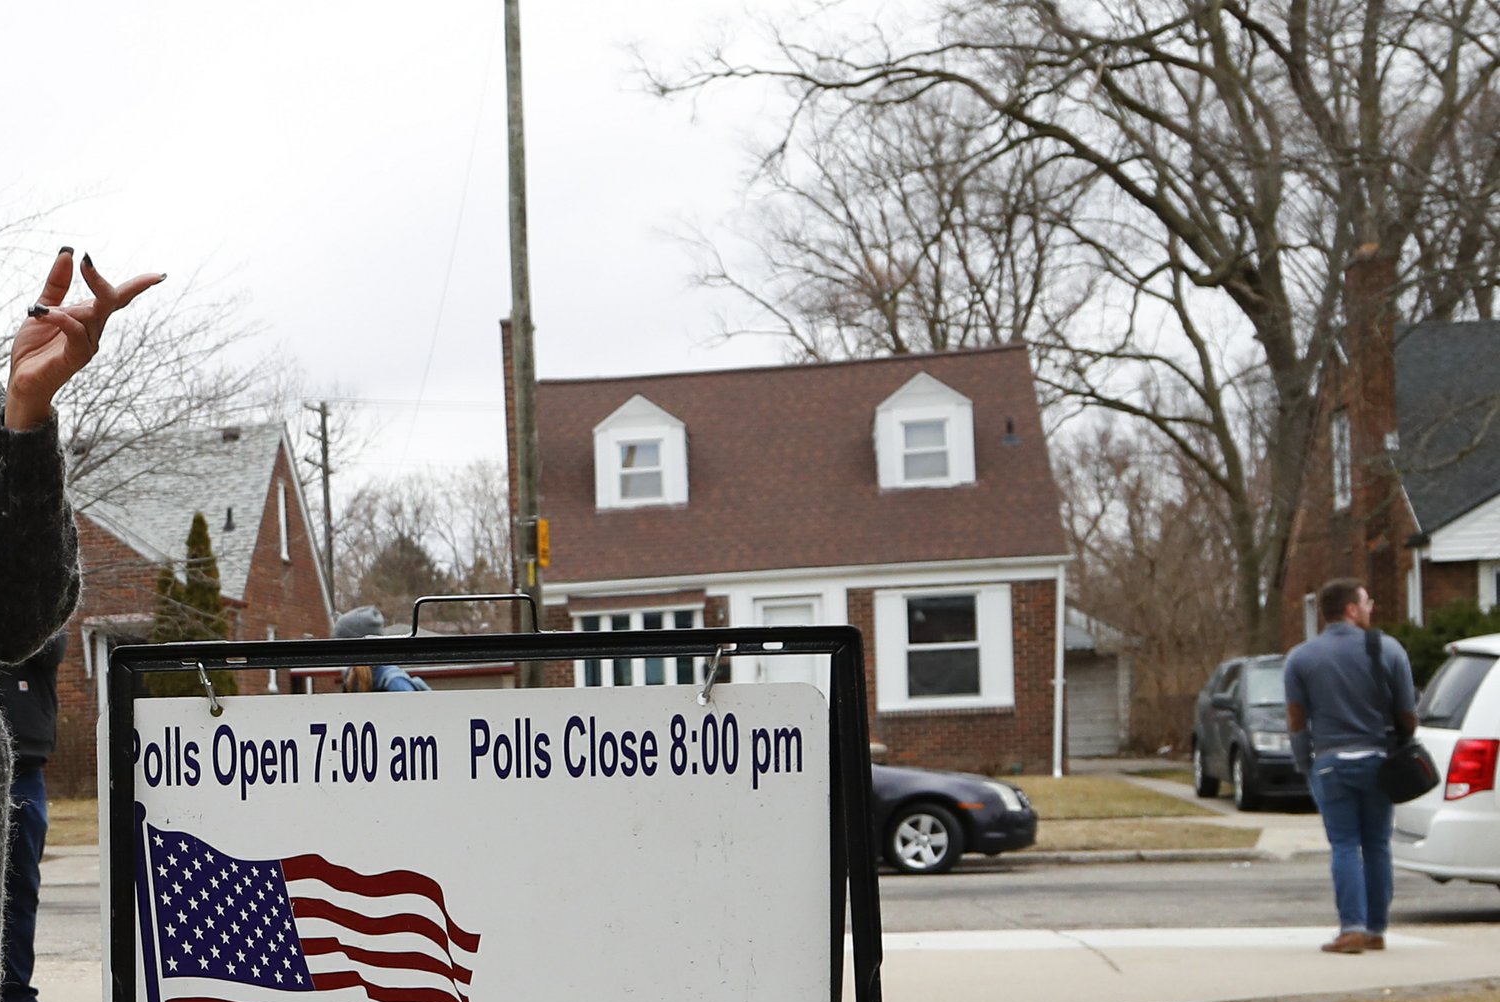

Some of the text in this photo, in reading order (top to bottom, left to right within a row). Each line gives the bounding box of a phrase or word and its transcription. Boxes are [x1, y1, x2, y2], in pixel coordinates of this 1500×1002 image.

[213, 724, 299, 801] Open
[309, 722, 378, 784] 7:00
[389, 736, 438, 782] am
[470, 718, 552, 780] Polls
[563, 716, 658, 778] Close
[669, 713, 739, 776] 8:00
[752, 728, 803, 790] pm
